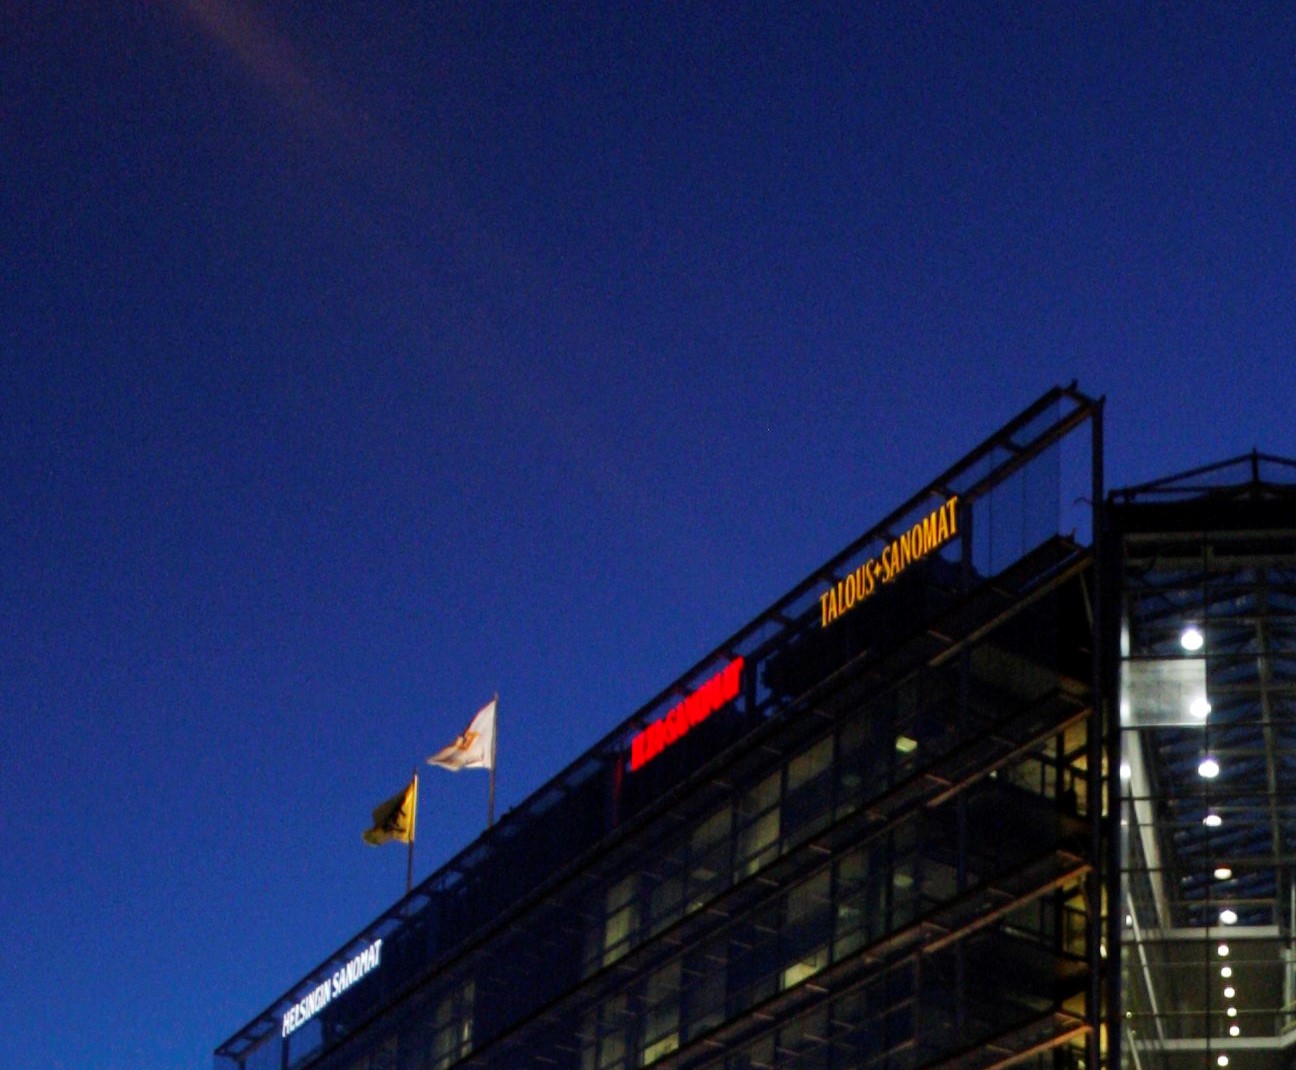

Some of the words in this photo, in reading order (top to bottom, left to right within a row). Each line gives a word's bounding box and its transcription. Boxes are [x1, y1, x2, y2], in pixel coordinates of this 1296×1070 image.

[819, 557, 876, 629] TALOUS
[881, 495, 958, 584] SANOMAT
[332, 938, 382, 998] SANOMAT
